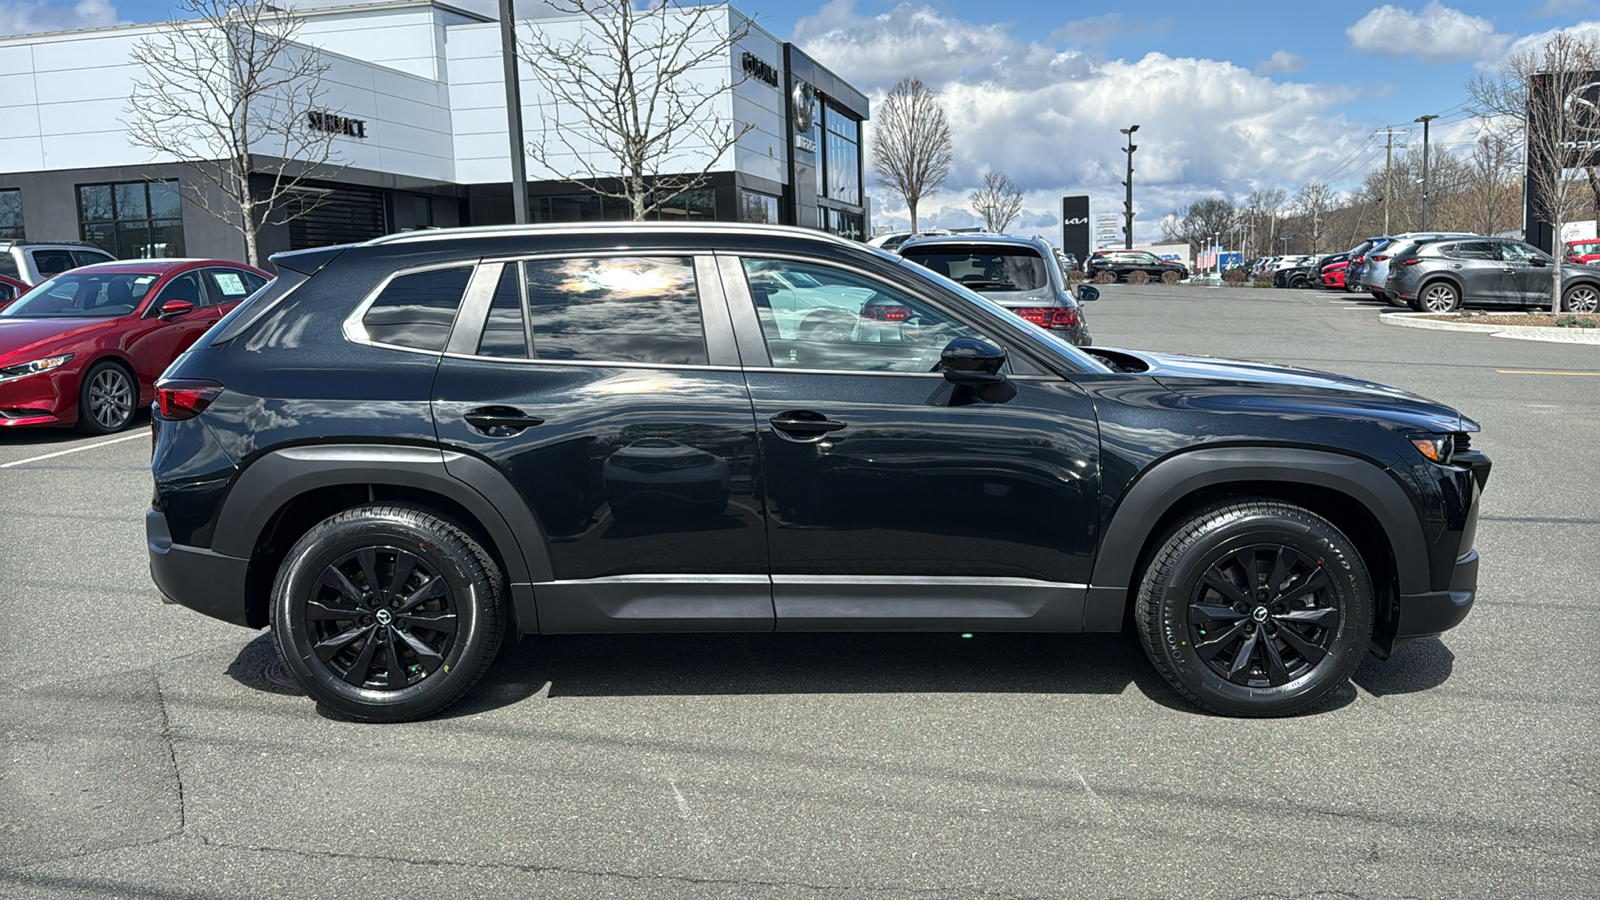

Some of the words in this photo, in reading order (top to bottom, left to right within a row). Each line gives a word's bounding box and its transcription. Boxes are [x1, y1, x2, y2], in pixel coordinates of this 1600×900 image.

[1064, 217, 1088, 225] KIA
[1317, 538, 1351, 570] AVID
[1165, 600, 1186, 666] YOKOHAMA
